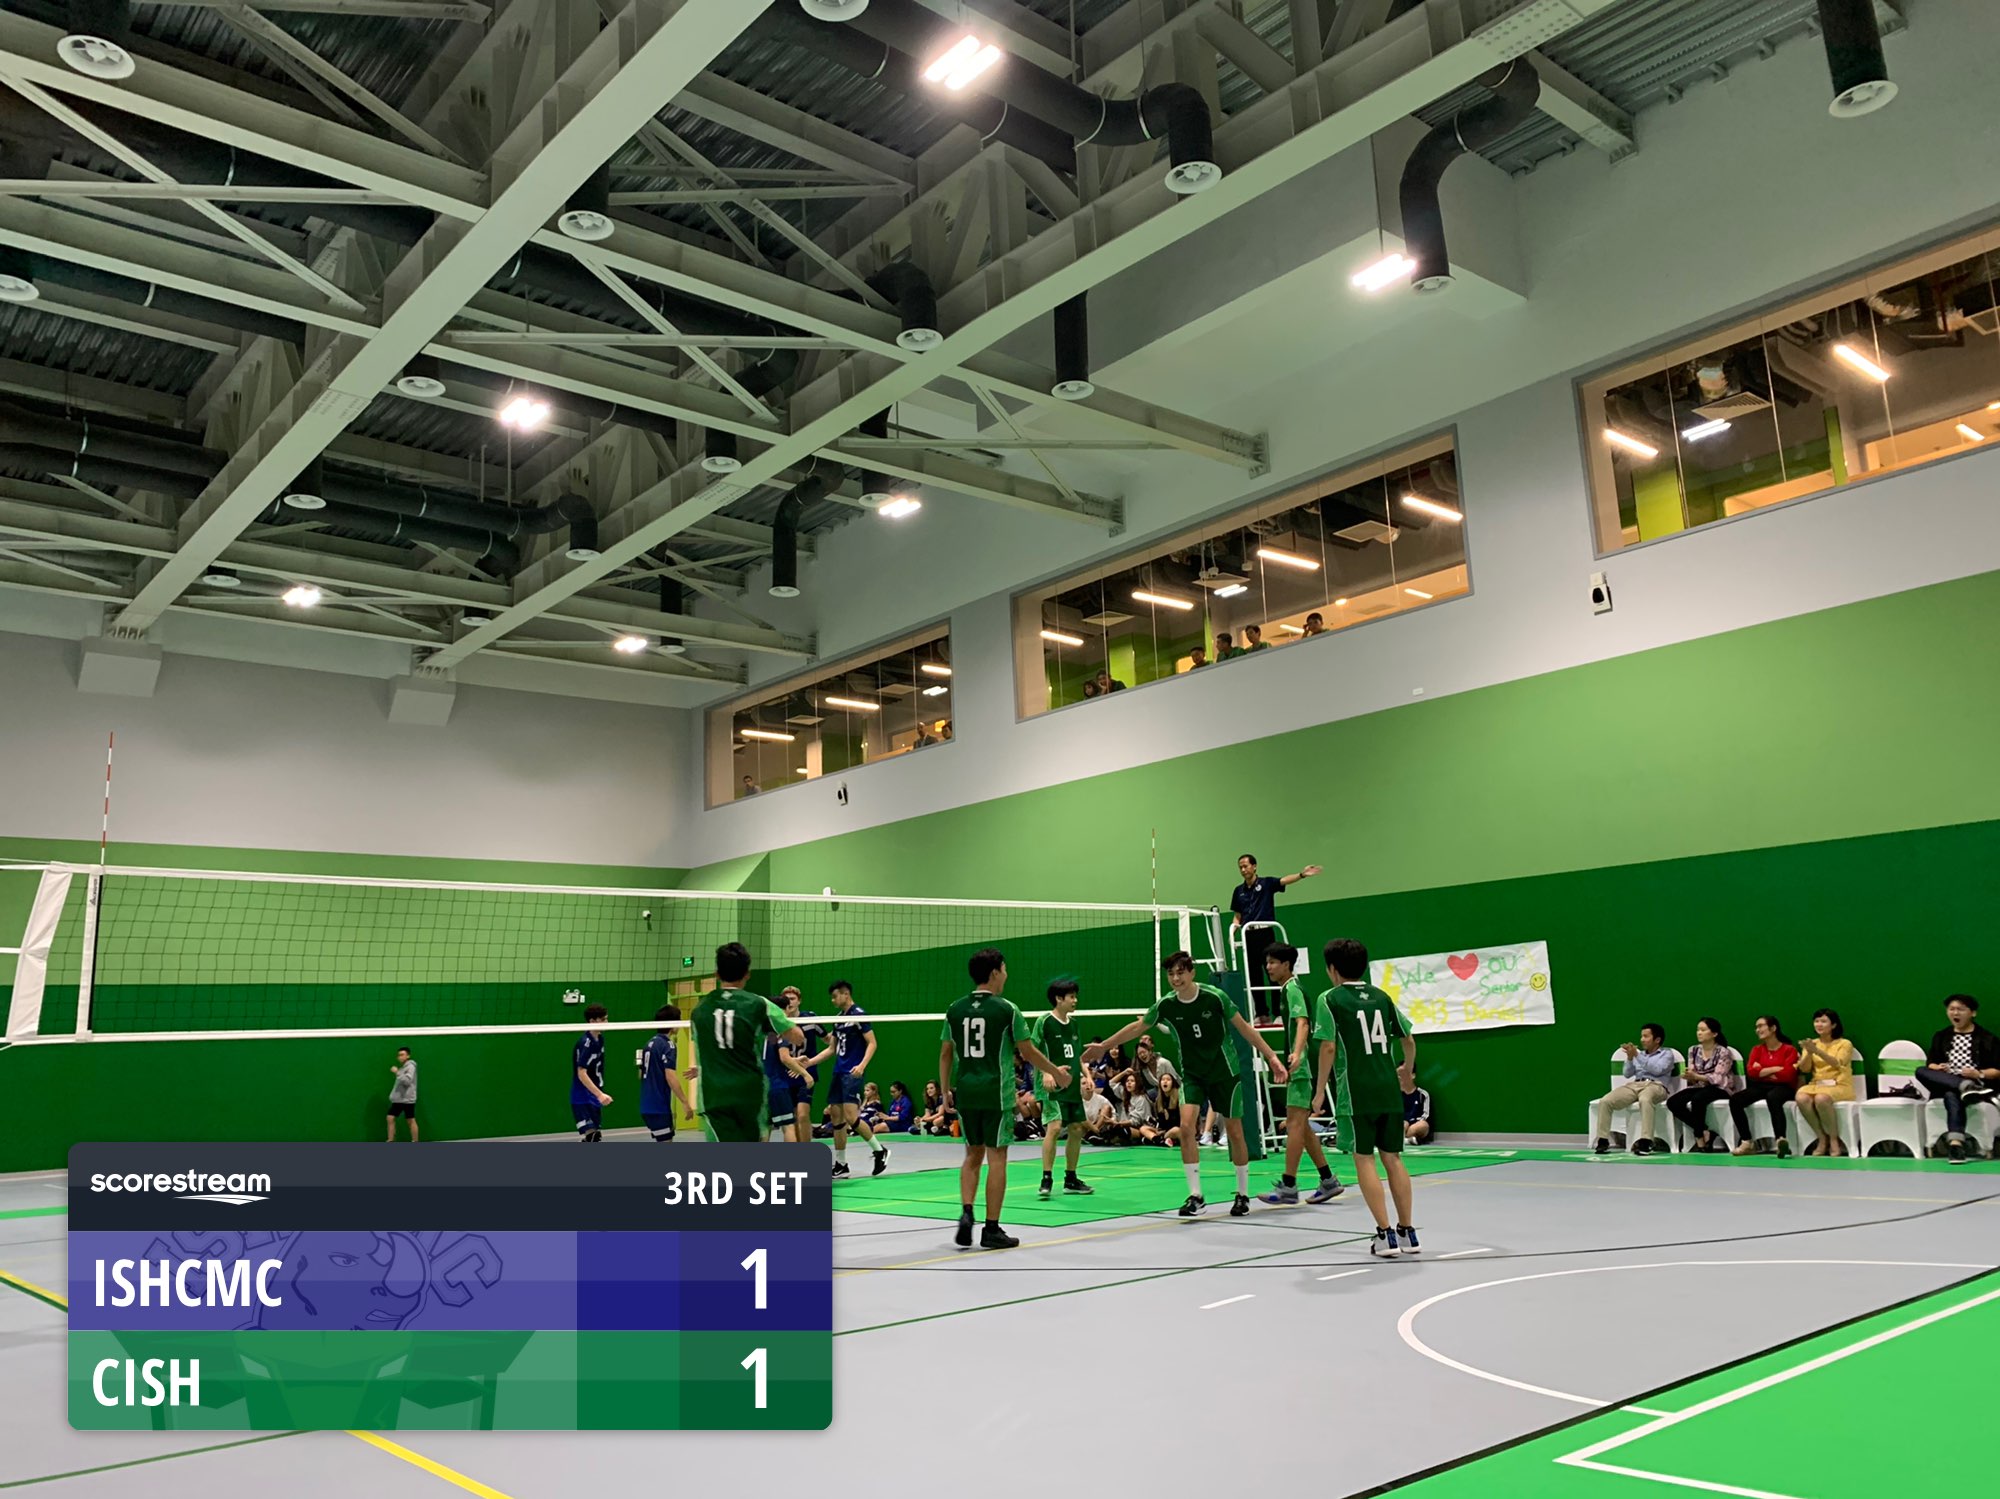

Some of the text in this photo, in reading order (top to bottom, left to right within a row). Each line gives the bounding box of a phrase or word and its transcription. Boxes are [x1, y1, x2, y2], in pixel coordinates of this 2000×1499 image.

[1394, 961, 1437, 989] We
[712, 1007, 735, 1050] 11
[962, 1016, 986, 1058] 13
[1193, 1023, 1202, 1038] 9
[1356, 1009, 1388, 1055] 14
[1063, 1043, 1075, 1059] 20
